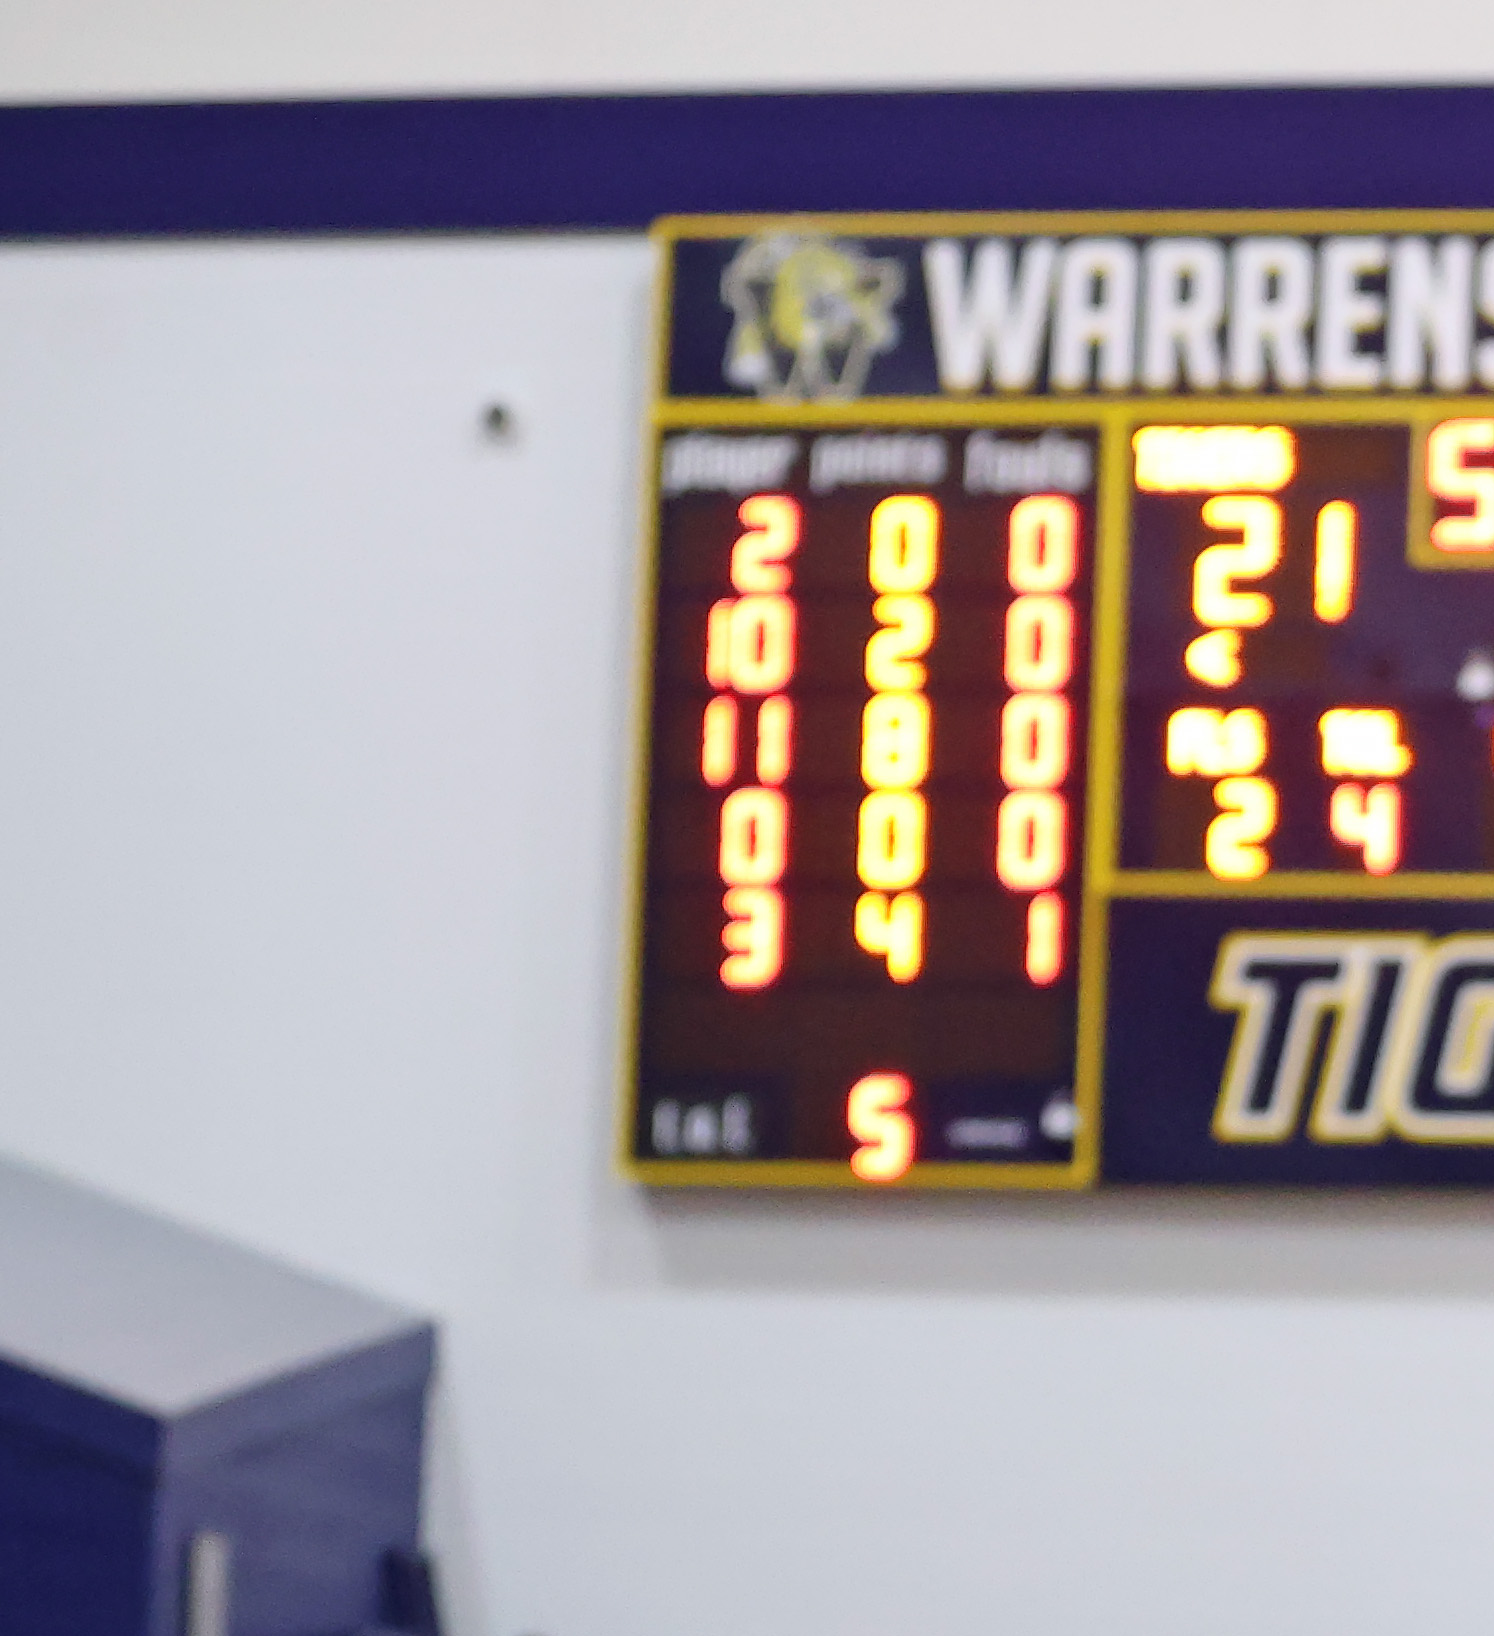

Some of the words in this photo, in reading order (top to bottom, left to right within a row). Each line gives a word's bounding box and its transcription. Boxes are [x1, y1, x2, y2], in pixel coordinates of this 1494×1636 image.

[730, 493, 800, 594] 2
[868, 494, 941, 594] 0
[1008, 494, 1077, 594] 0
[1190, 494, 1357, 622] 21
[706, 596, 797, 696] 10
[865, 594, 936, 693] 2
[1003, 594, 1072, 694] 0
[702, 696, 792, 787] 11
[861, 691, 930, 791] 8
[1000, 691, 1068, 790] 0
[719, 787, 788, 888] 0
[857, 789, 927, 890] 0
[996, 788, 1065, 891] 0
[1206, 776, 1278, 882] 2
[1329, 782, 1401, 877] 4
[719, 887, 786, 989] 3
[853, 892, 924, 984] 4
[1026, 892, 1063, 985] 1
[846, 1073, 914, 1182] 5
